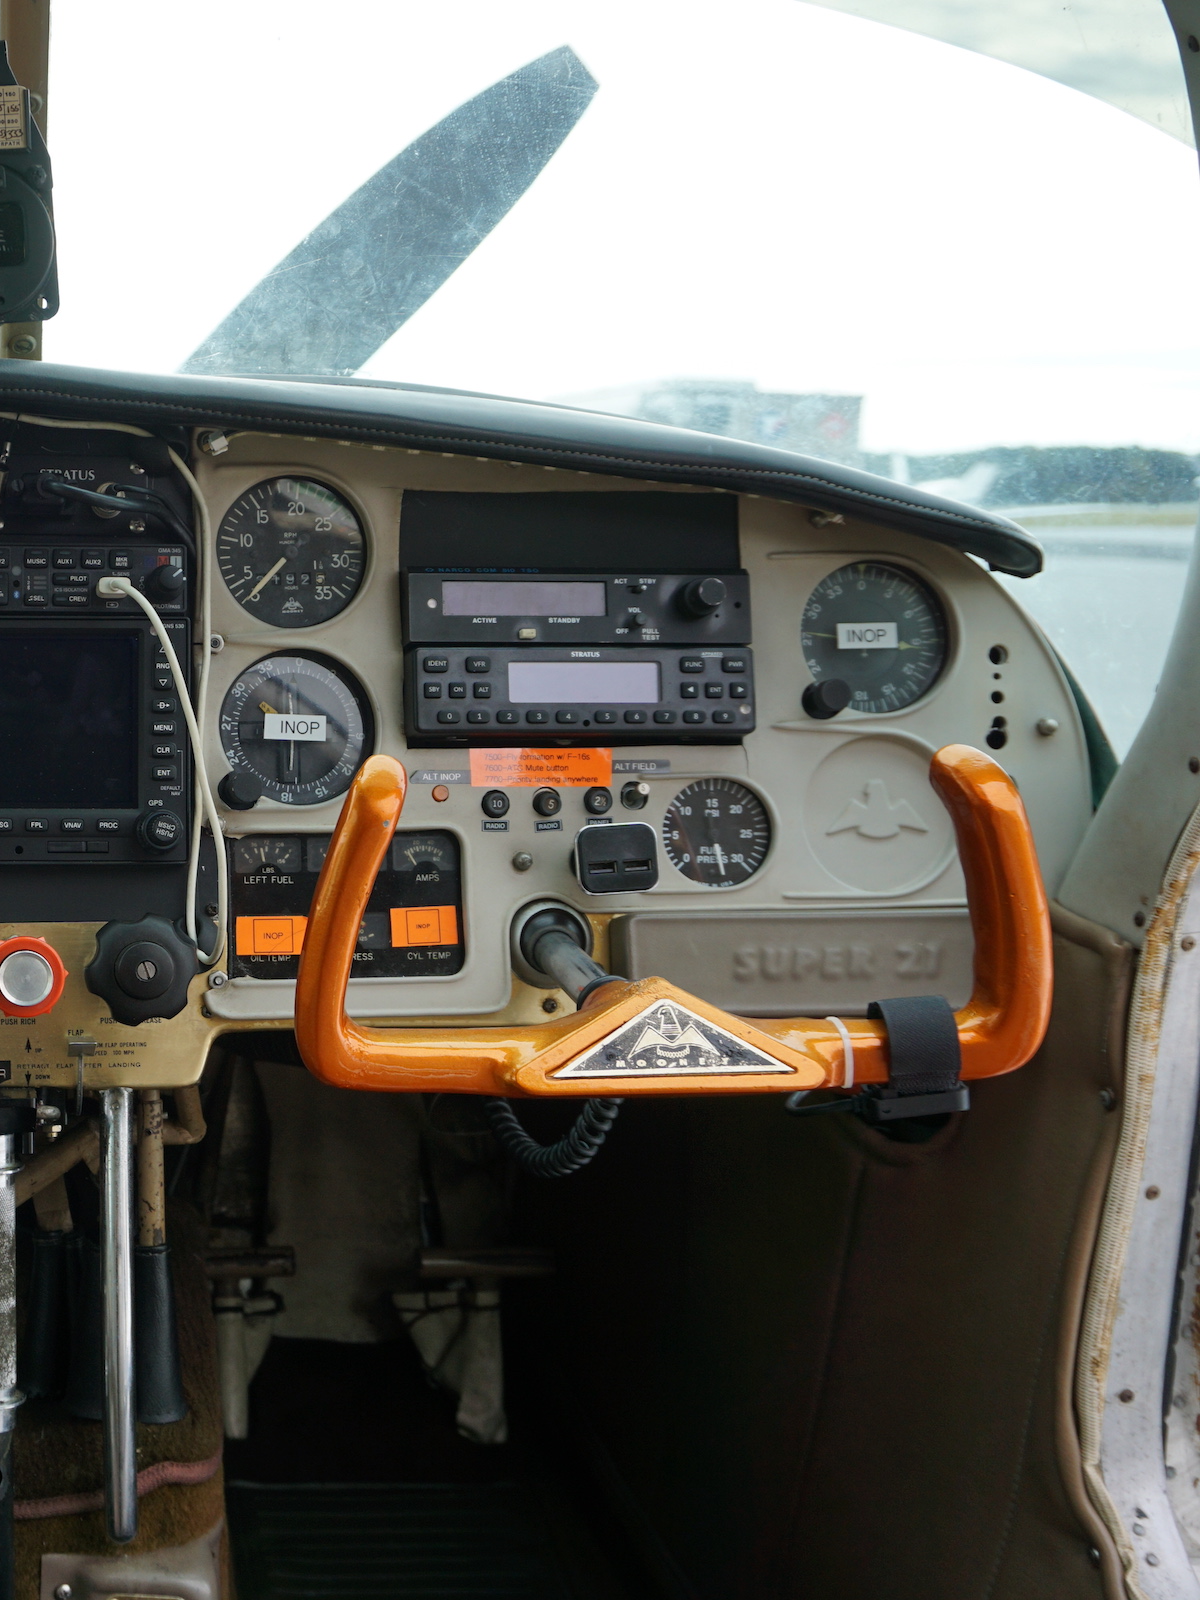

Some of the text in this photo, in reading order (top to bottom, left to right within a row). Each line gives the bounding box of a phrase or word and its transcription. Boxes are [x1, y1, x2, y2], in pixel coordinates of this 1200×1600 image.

[287, 502, 305, 516] 20
[257, 510, 269, 524] 15
[315, 517, 332, 531] 25
[331, 554, 349, 568] 30
[315, 586, 332, 600] 35
[847, 629, 887, 642] INOP
[153, 724, 173, 732] MENU
[280, 720, 320, 734] INOP
[706, 798, 719, 807] 15
[99, 821, 118, 829] PROC
[740, 830, 752, 838] 25
[731, 854, 743, 863] 30
[243, 876, 294, 884] LEFT FUEL
[415, 874, 440, 882] AMPS
[263, 932, 284, 940] INOP
[407, 951, 451, 960] CYL TEMP
[733, 941, 941, 981] SUPER 21
[615, 1058, 729, 1067] MOONEY
